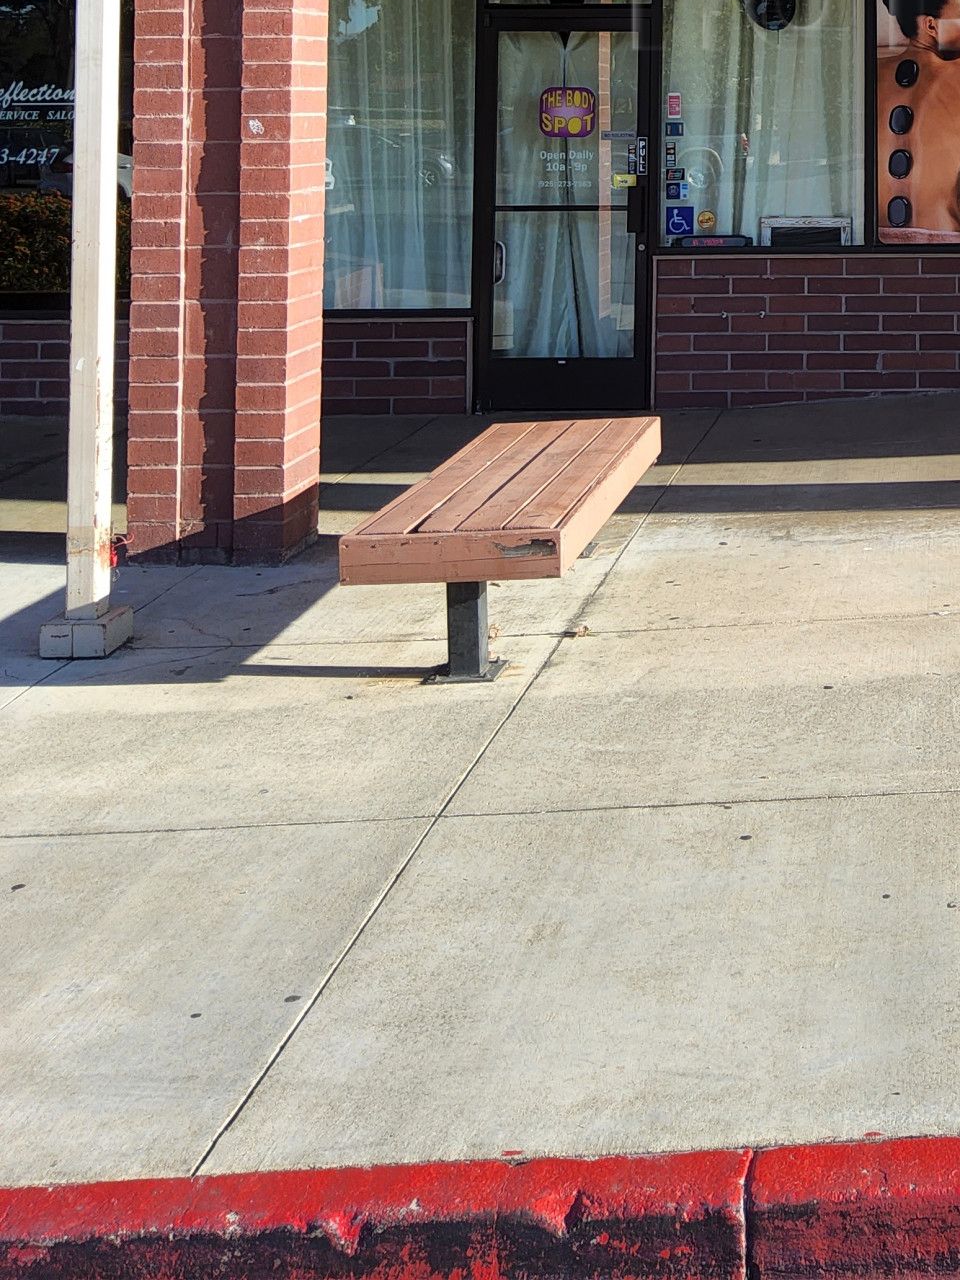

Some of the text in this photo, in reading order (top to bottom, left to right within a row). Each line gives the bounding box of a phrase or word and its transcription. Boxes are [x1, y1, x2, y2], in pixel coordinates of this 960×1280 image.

[542, 90, 594, 111] THE BODY
[0, 110, 75, 120] ERVICE SALO
[541, 112, 594, 134] SPOT
[0, 148, 60, 164] 3-4247
[540, 150, 594, 160] Open Daily
[546, 162, 566, 171] 10a
